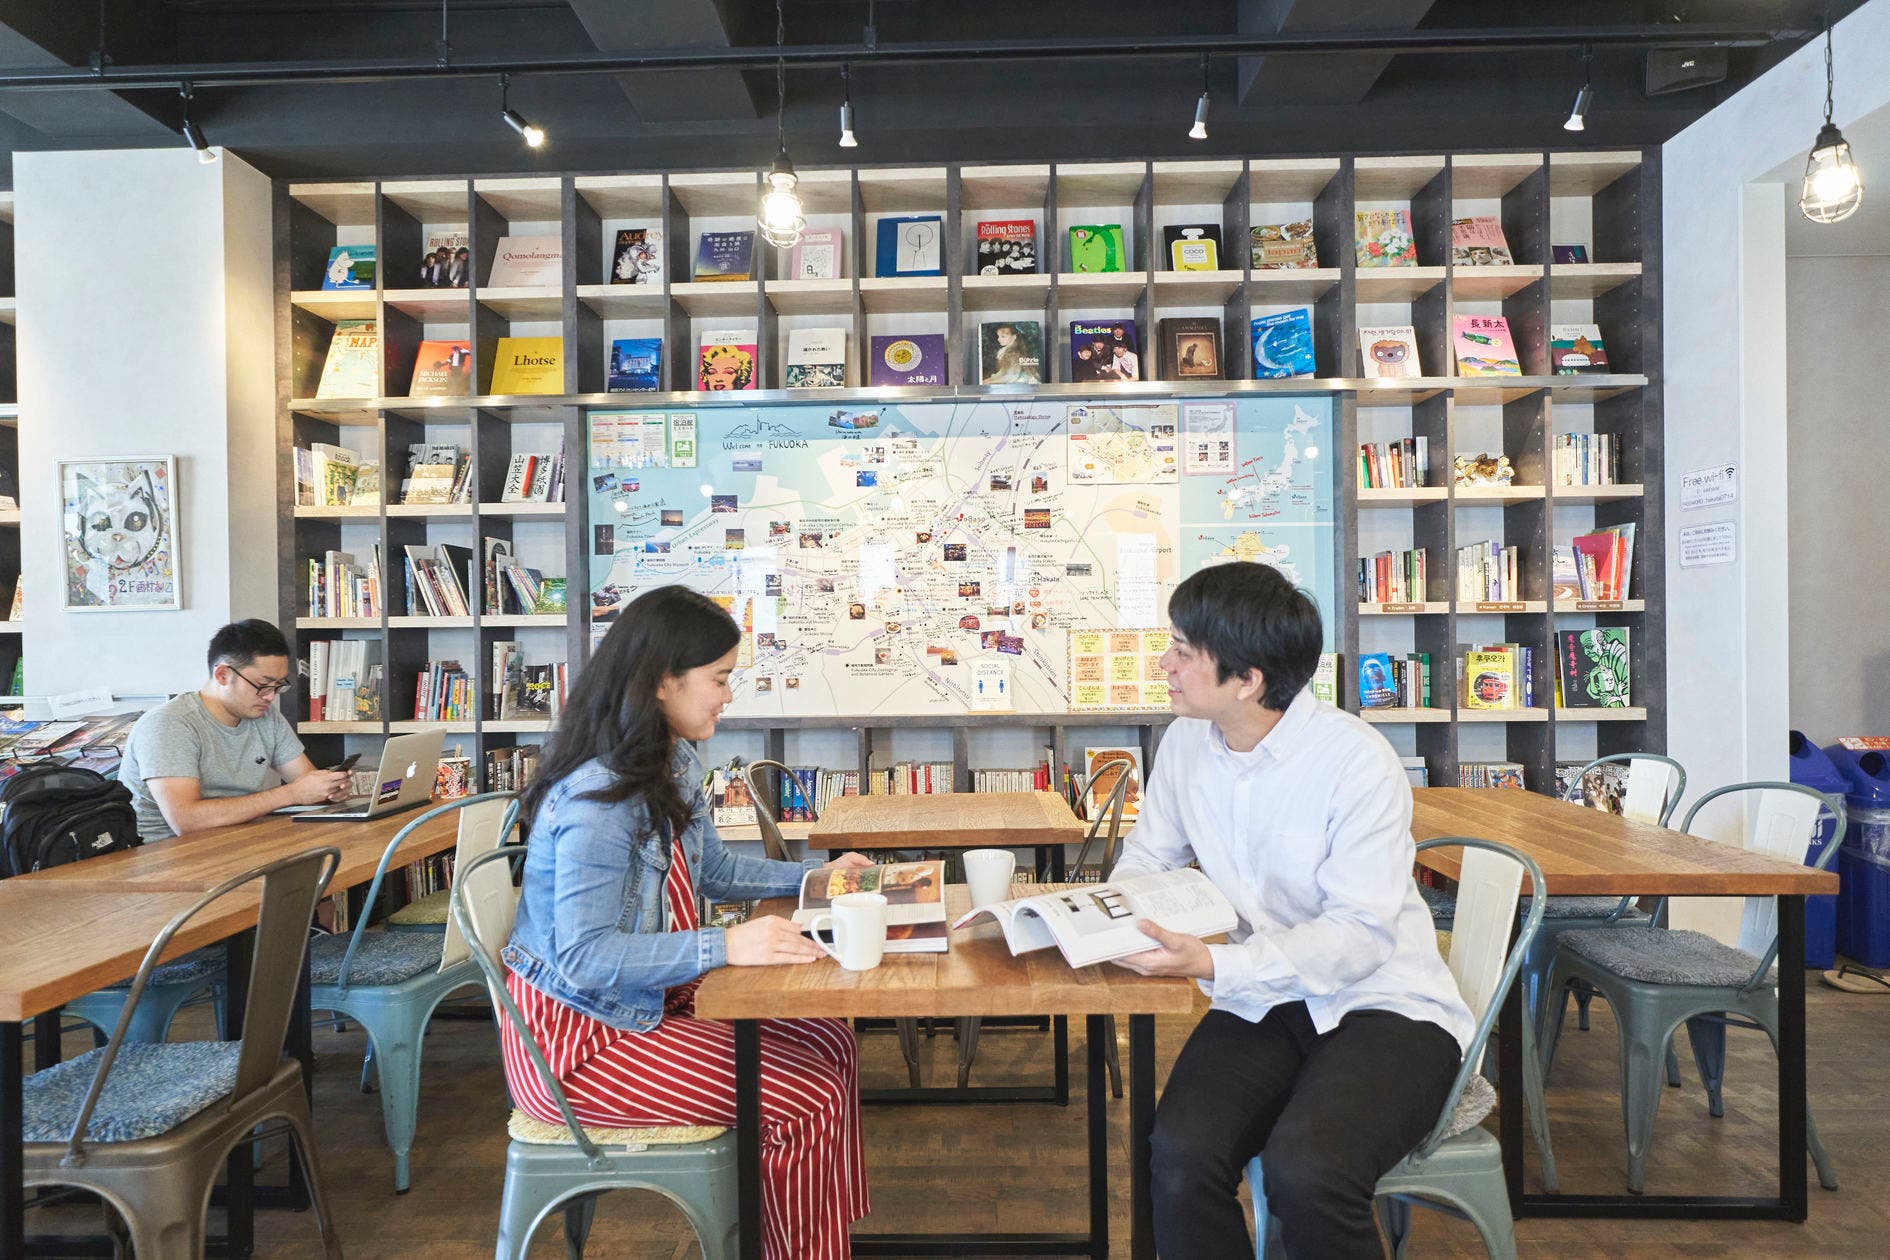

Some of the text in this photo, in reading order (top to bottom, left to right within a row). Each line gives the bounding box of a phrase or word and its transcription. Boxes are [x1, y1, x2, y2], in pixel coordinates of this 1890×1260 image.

[1007, 224, 1031, 233] Stones
[621, 230, 663, 241] Audrey
[1470, 319, 1505, 329] 長新太
[1074, 326, 1112, 335] Beatles
[350, 336, 377, 348] MAP
[514, 355, 556, 366] Lhotse
[907, 375, 937, 383] 太陽と月
[722, 441, 751, 450] Welcome
[768, 439, 809, 449] FUKUOKA
[1683, 476, 1702, 488] Free
[783, 779, 791, 798] Japan
